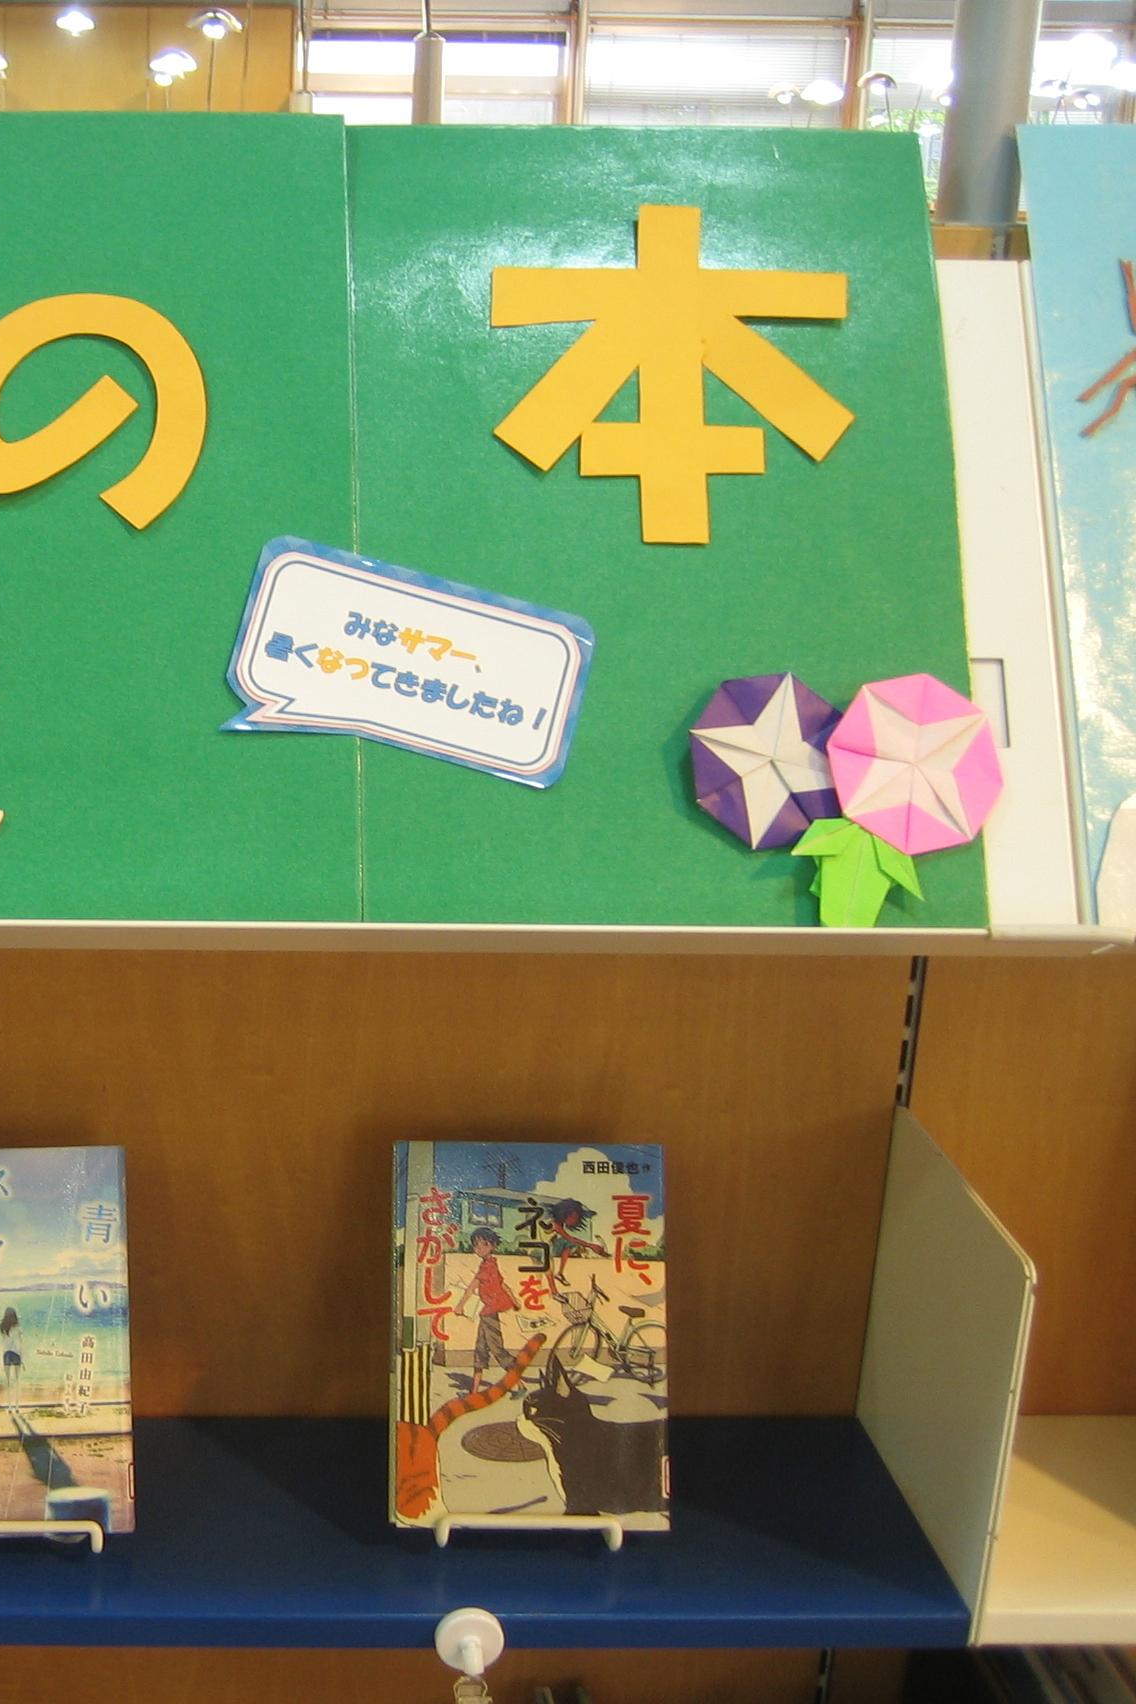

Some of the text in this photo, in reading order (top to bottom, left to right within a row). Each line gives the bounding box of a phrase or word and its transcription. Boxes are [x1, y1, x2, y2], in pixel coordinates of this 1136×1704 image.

[343, 611, 483, 674] みなサマー、
[79, 1204, 118, 1310] 青い
[415, 1187, 460, 1341] さがして
[515, 1196, 553, 1311] ネコを
[611, 1194, 653, 1286] 夏に、
